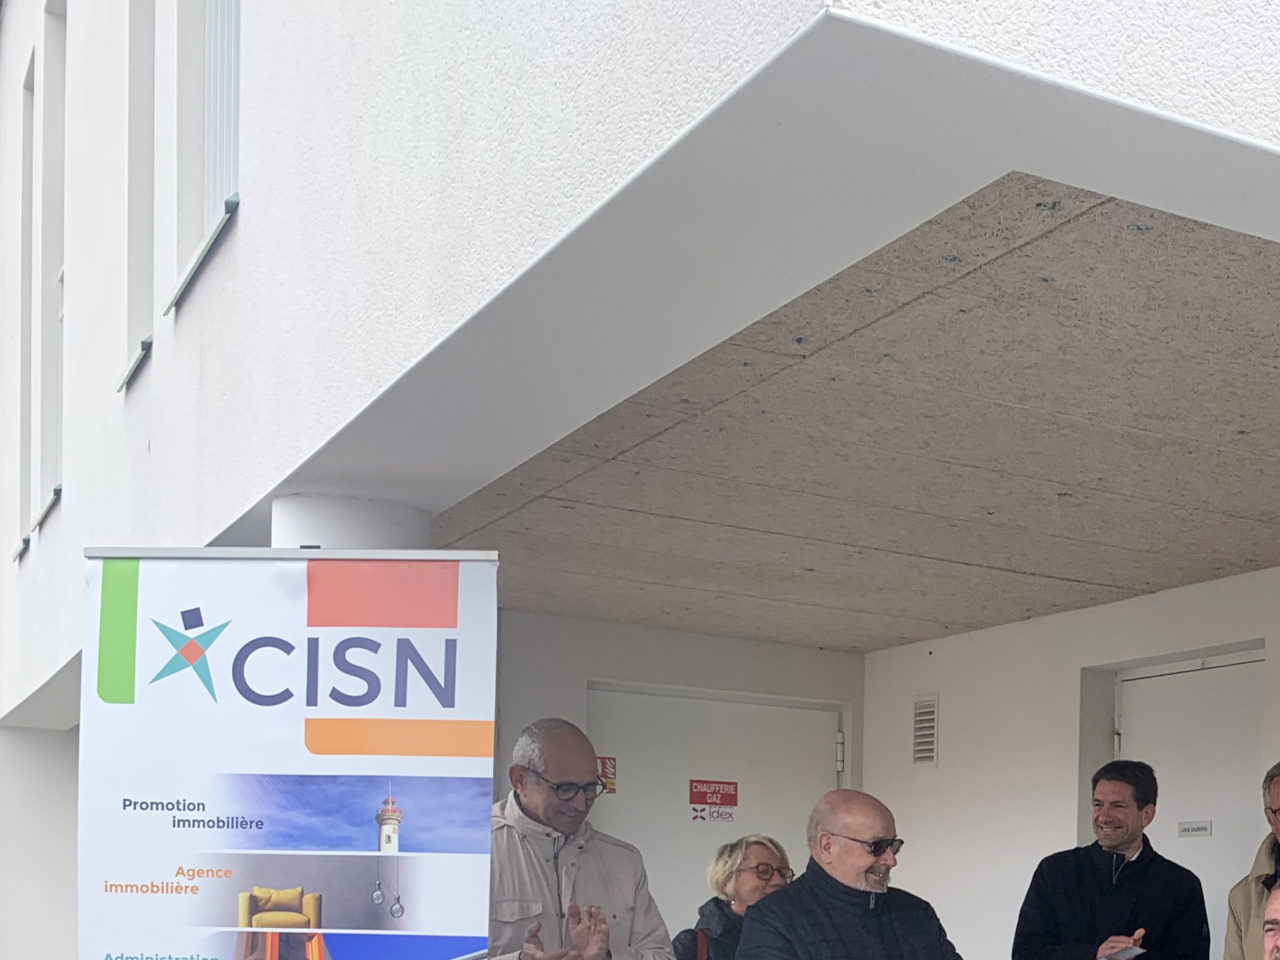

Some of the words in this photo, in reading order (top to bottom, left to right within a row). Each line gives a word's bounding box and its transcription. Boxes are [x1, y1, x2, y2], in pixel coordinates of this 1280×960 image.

[231, 635, 458, 709] CISN
[692, 782, 736, 795] CHAUFFERIE
[122, 798, 206, 812] Promotion
[706, 793, 722, 804] GAZ
[709, 807, 734, 820] idex
[172, 815, 264, 830] immobilière
[175, 865, 233, 880] Agence
[104, 880, 199, 895] immobilière
